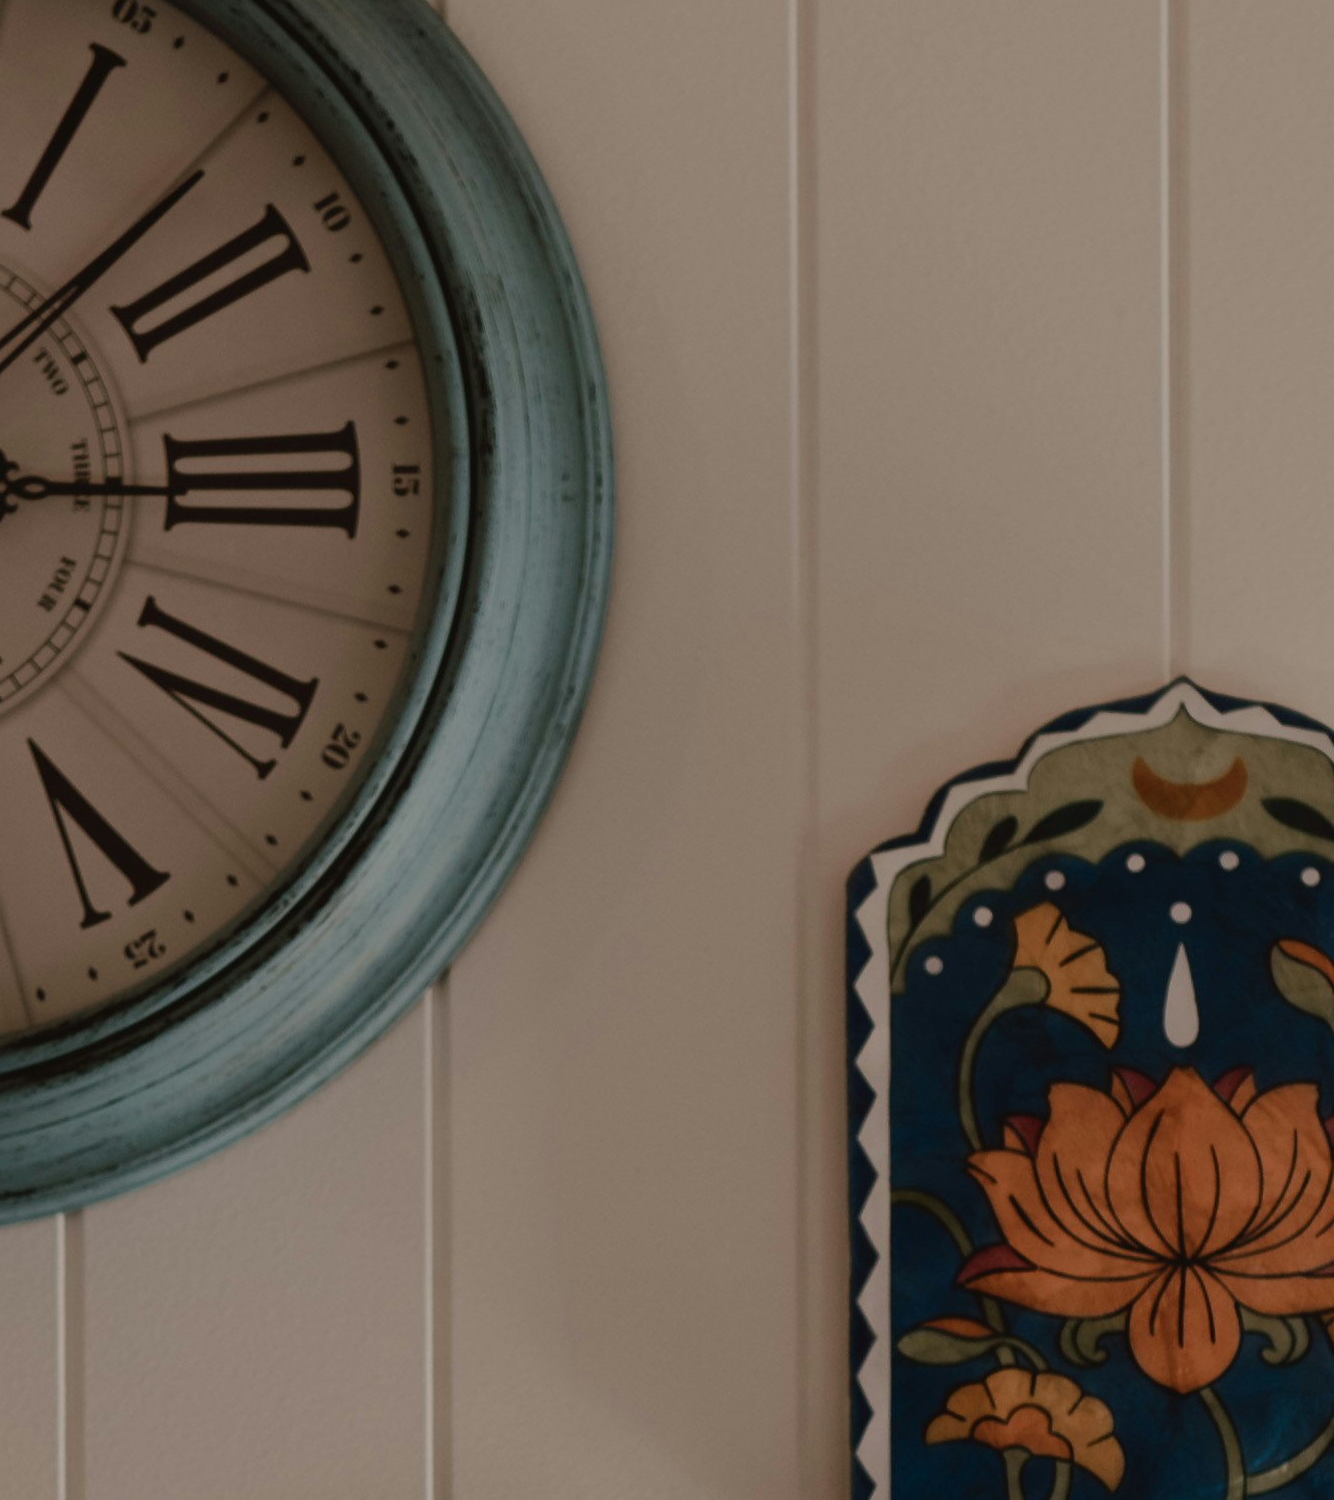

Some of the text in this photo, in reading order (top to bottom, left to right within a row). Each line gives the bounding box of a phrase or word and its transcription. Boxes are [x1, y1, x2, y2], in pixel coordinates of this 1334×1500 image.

[0, 41, 128, 232] I
[313, 190, 354, 237] 10
[109, 201, 312, 365] II
[33, 347, 69, 396] TWO
[163, 419, 361, 540] III
[391, 461, 421, 499] 15
[37, 555, 77, 613] FOUR
[115, 595, 320, 781] IV
[320, 721, 363, 772] 20
[27, 737, 171, 930] V
[123, 928, 168, 971] 25
